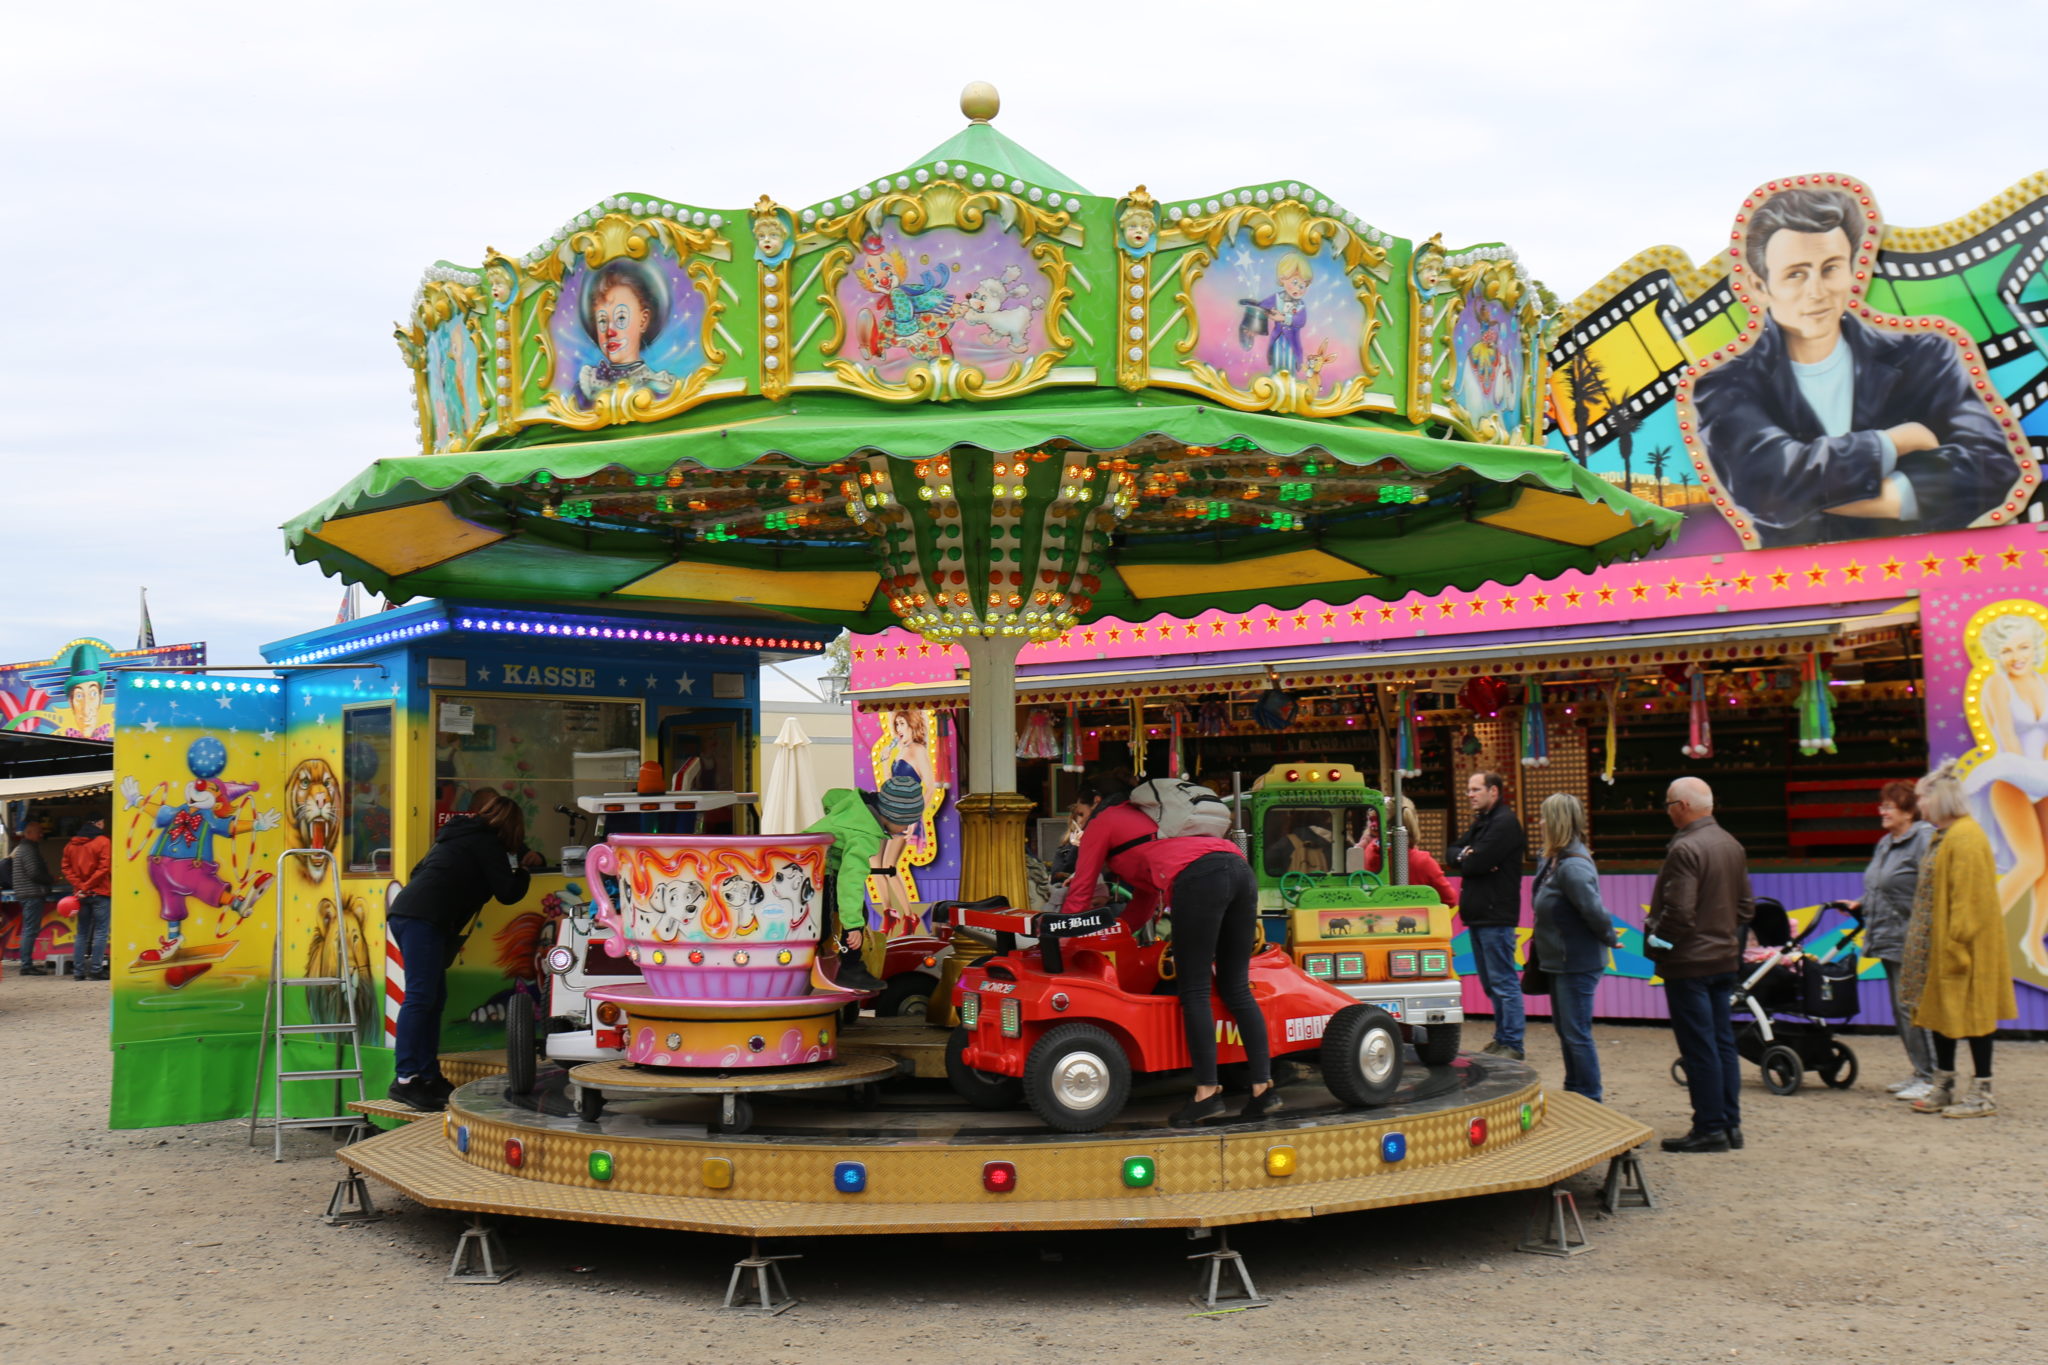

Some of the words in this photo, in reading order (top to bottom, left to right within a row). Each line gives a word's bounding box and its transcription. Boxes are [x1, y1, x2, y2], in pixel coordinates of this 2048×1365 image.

[502, 664, 595, 688] KASSE
[1279, 790, 1325, 802] SAFARI
[1328, 789, 1363, 802] PARK
[1050, 920, 1067, 932] pit
[1069, 916, 1102, 930] Bull
